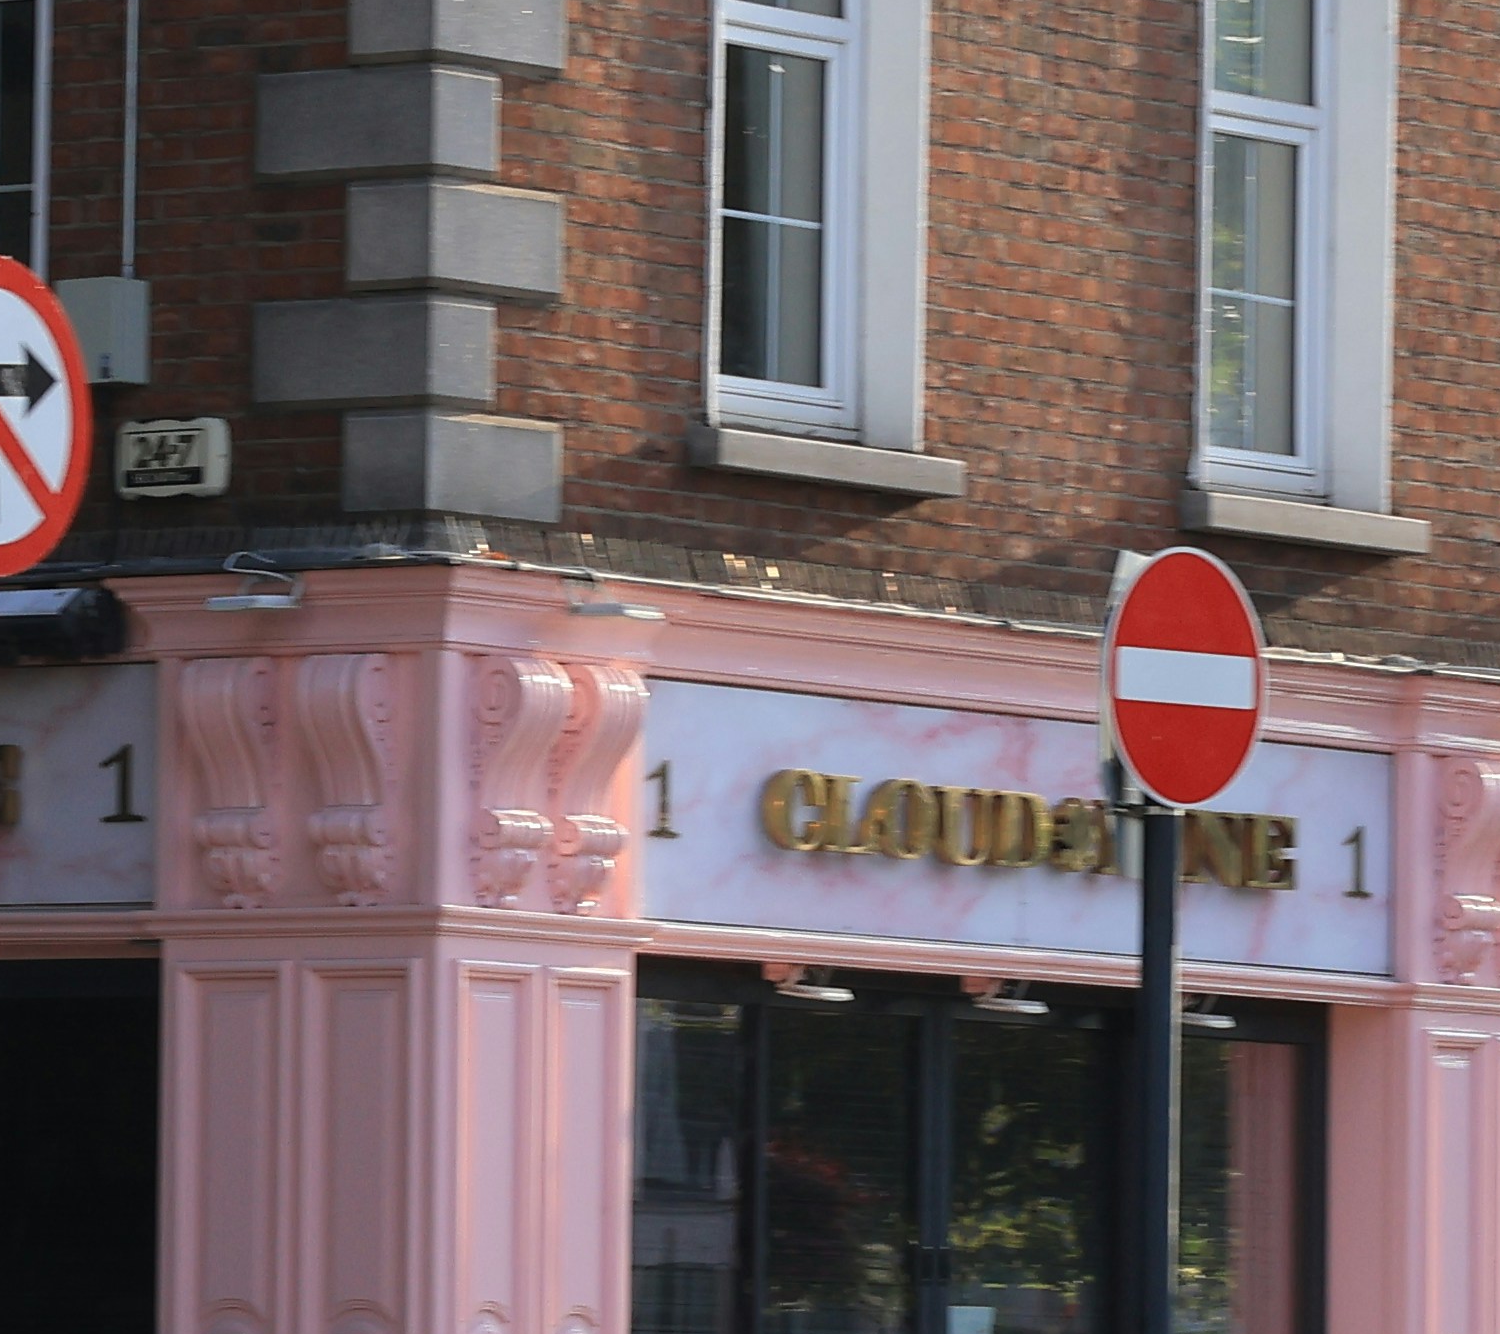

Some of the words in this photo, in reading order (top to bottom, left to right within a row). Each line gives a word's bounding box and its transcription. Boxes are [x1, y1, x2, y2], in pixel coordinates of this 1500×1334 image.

[98, 743, 147, 824] 1
[646, 760, 682, 839] 1
[760, 768, 1054, 870] CLOUD
[1342, 825, 1373, 899] 1
